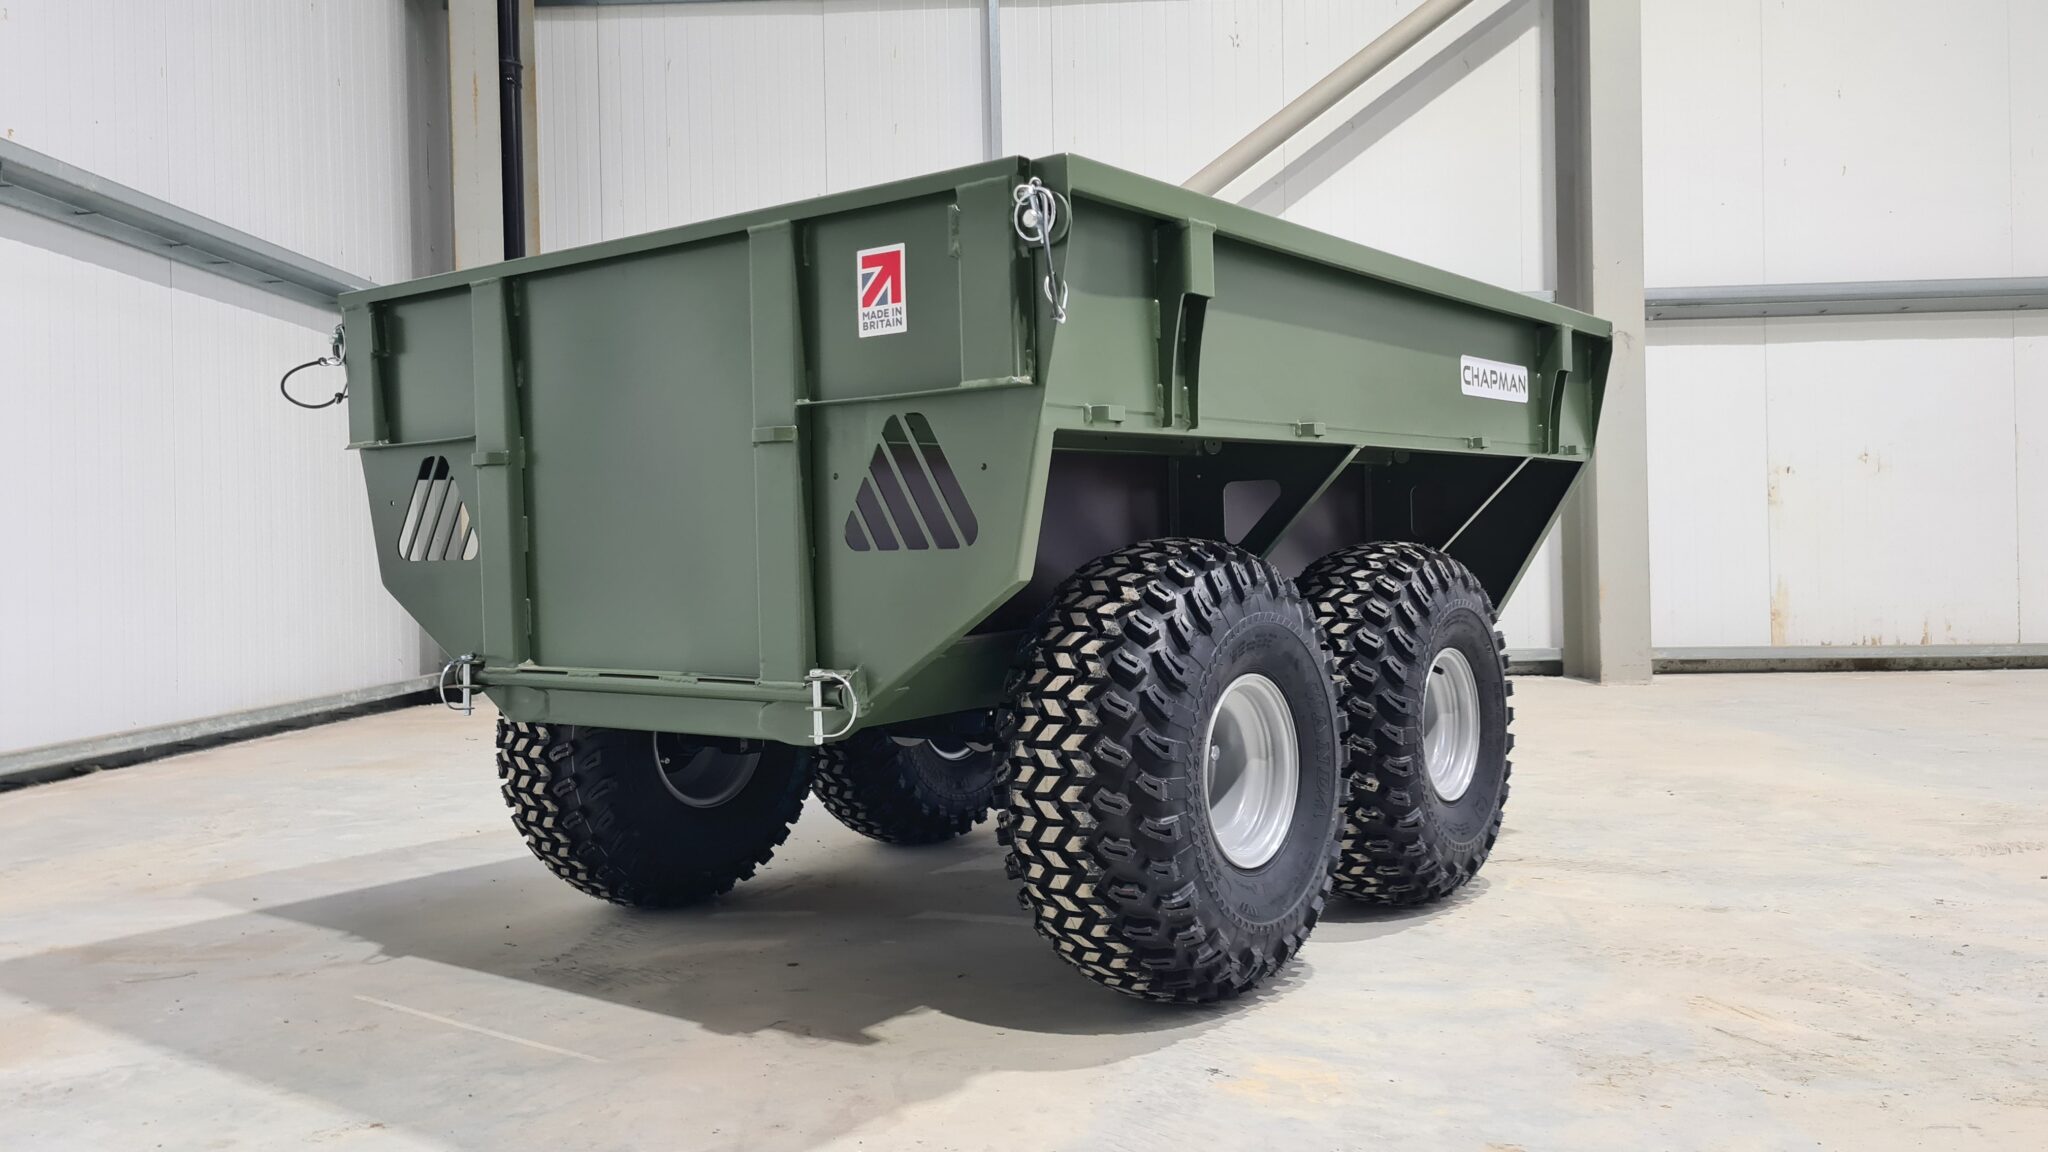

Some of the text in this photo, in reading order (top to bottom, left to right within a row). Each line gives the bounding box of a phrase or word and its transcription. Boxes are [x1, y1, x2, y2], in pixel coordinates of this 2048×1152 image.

[862, 306, 903, 321] MADE IN
[862, 317, 903, 331] BRITAIN
[1462, 365, 1527, 394] CHAPMAN
